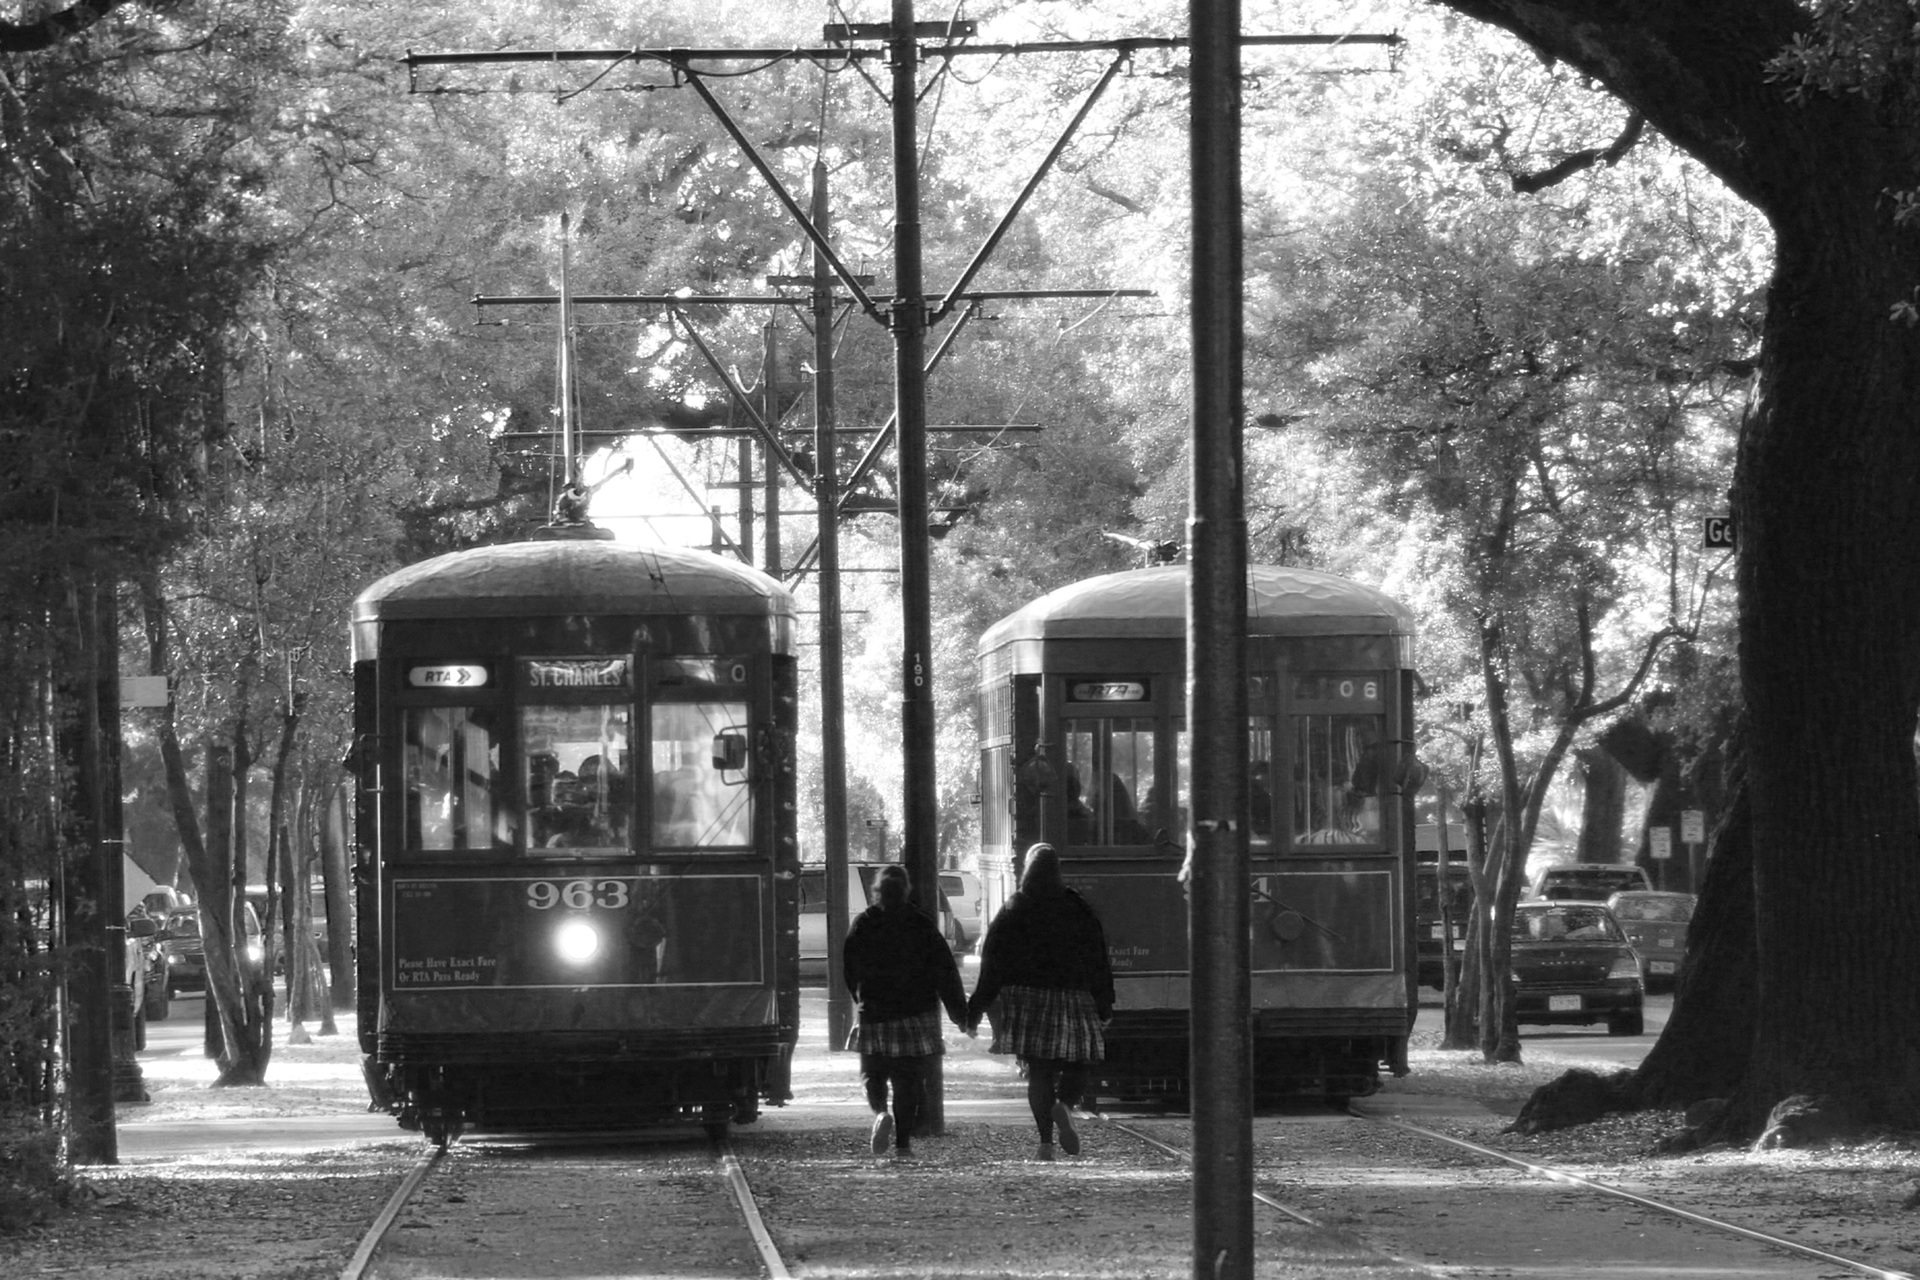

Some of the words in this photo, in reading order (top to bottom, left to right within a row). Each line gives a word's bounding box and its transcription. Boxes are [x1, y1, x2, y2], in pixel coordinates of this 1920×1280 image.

[424, 670, 452, 683] RTA
[530, 666, 551, 687] ST.
[553, 665, 622, 687] CHARLES
[914, 653, 923, 687] 190
[527, 880, 629, 910] 963
[1109, 945, 1131, 956] Exact
[1133, 944, 1151, 956] Fare
[399, 958, 424, 969] Please
[427, 957, 447, 968] Have
[450, 956, 475, 968] Exact
[478, 956, 497, 967] Fare
[1111, 957, 1134, 967] Ready
[400, 971, 411, 983] Or
[413, 971, 431, 982] RTA
[433, 971, 452, 982] Pass
[454, 970, 480, 983] Ready
